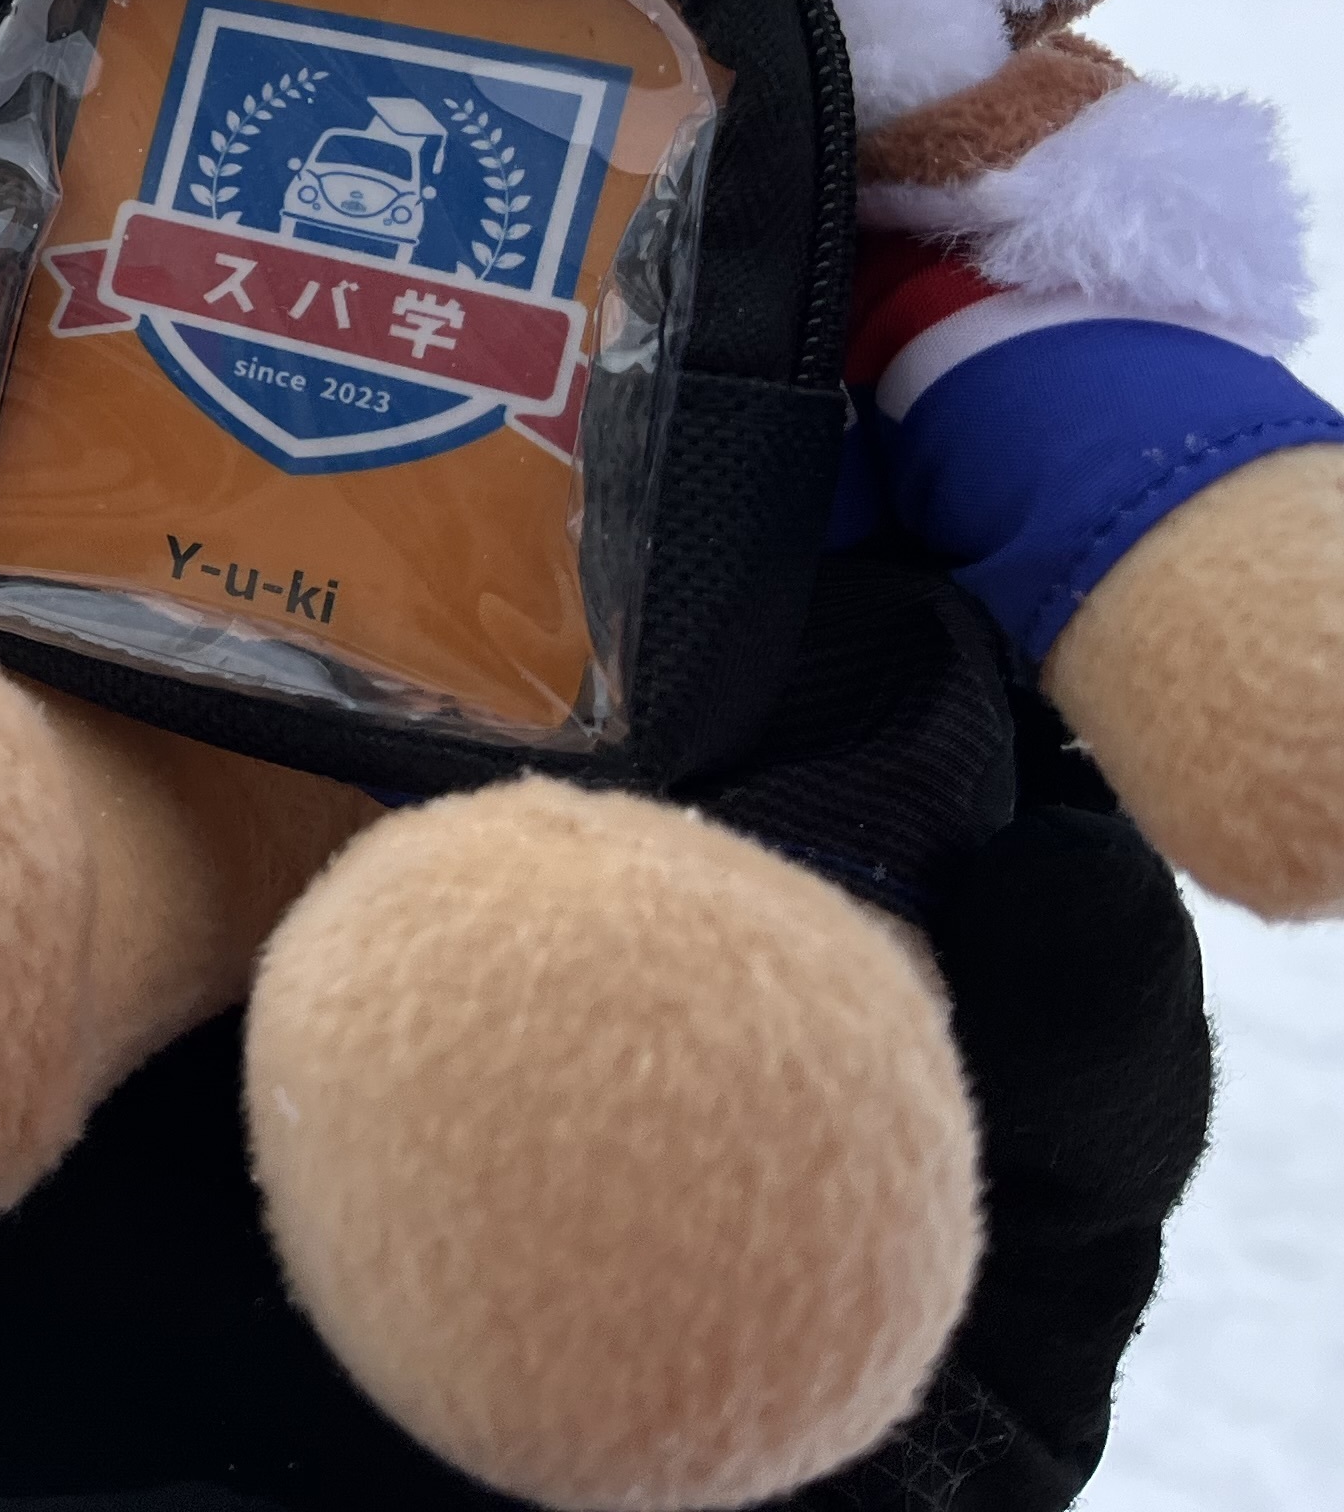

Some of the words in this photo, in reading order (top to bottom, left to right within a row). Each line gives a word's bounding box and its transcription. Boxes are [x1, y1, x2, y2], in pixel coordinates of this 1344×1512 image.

[203, 252, 466, 360] スバ学
[233, 356, 307, 392] since
[319, 377, 392, 414] 2023
[166, 533, 340, 625] Y-u-ki
